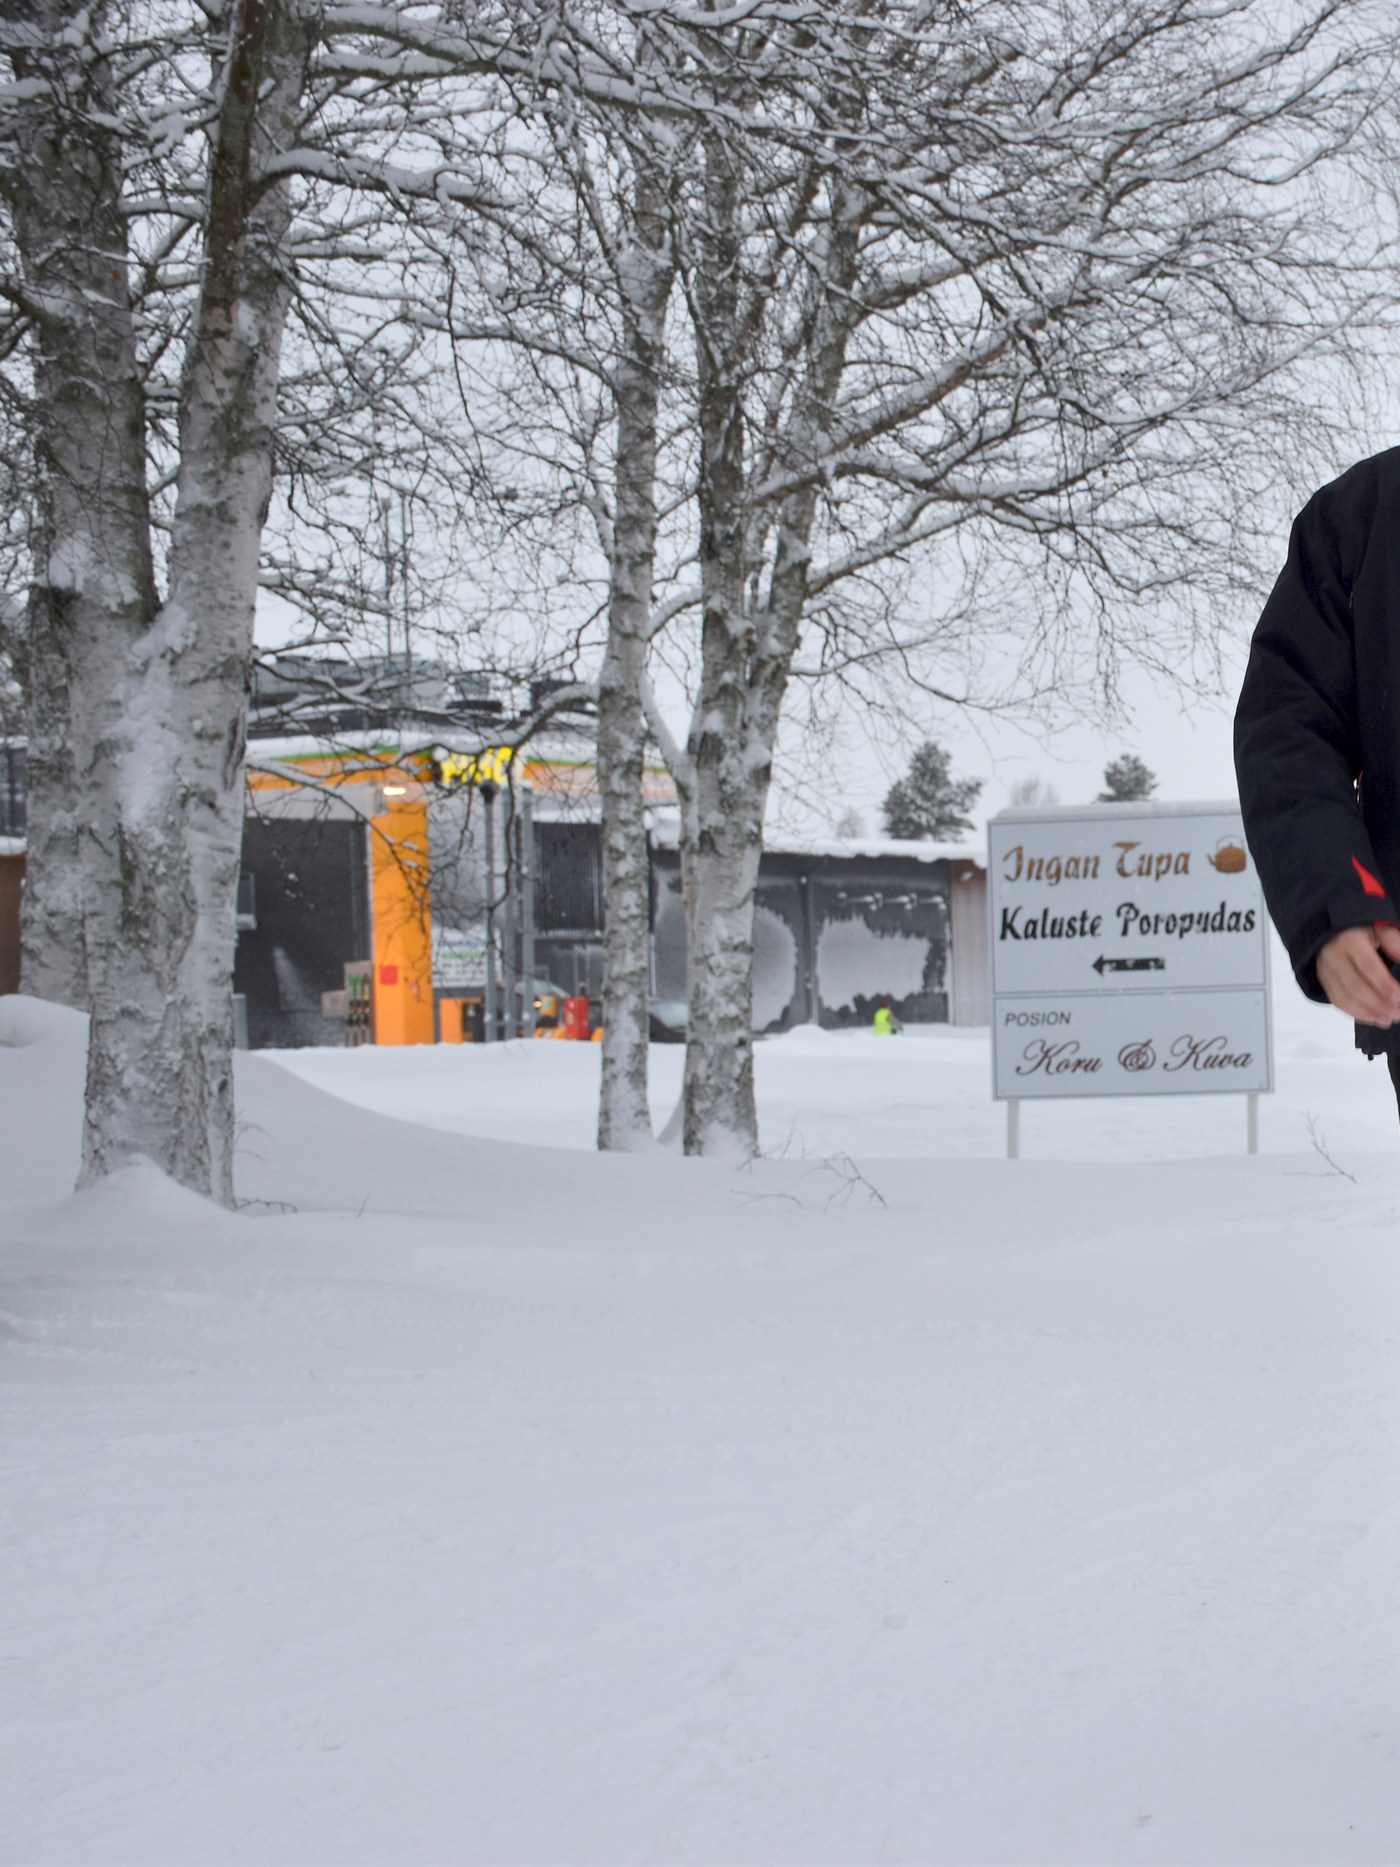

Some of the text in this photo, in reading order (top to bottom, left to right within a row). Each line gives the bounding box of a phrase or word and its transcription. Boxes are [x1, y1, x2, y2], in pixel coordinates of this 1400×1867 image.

[1003, 841, 1191, 886] Ingan Tupa
[1000, 901, 1256, 941] Kaluste Poropudas
[1005, 1012, 1072, 1027] POSION
[1016, 1039, 1103, 1076] Koru
[1163, 1035, 1253, 1072] Kuva
